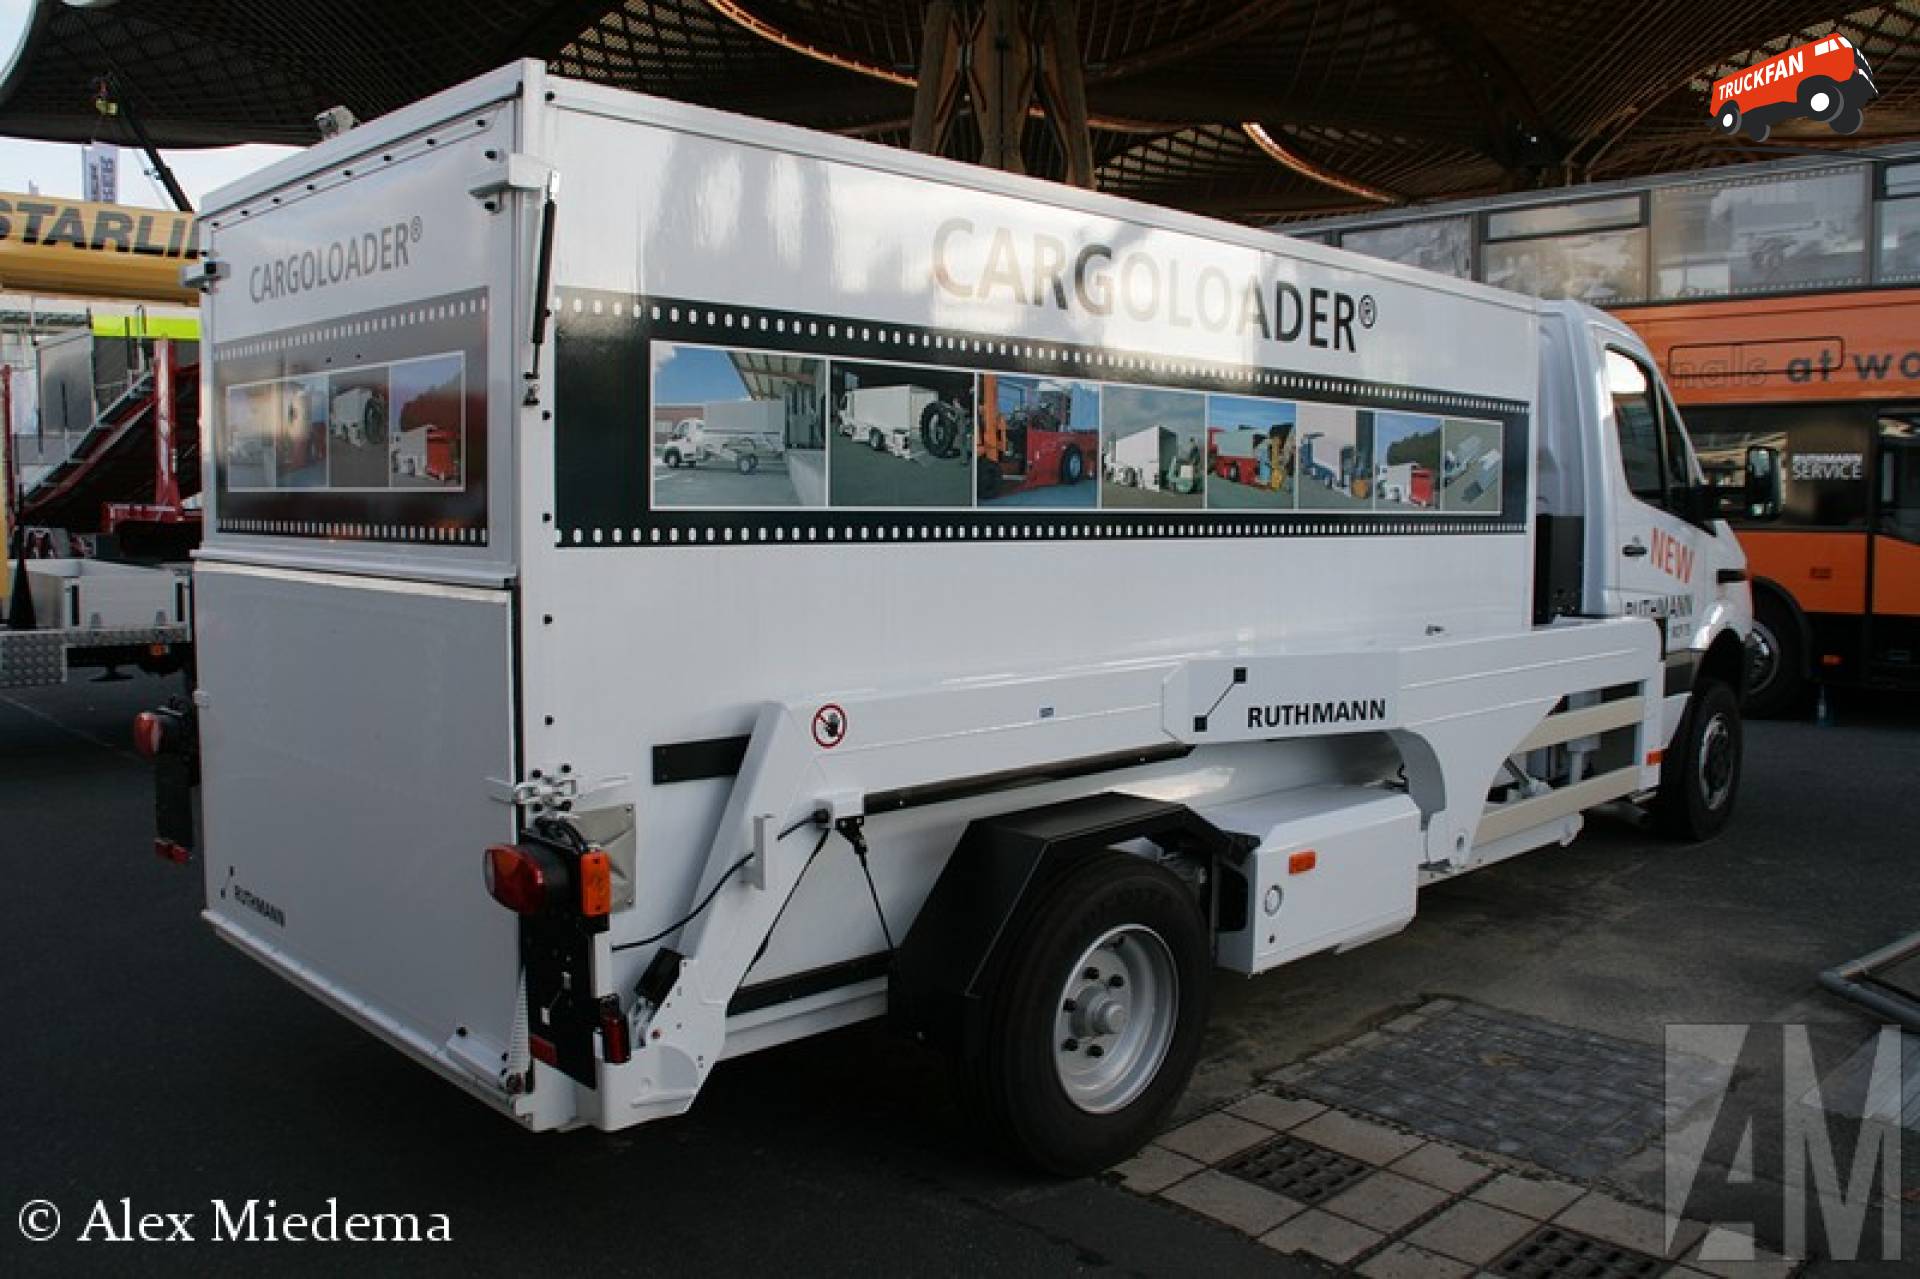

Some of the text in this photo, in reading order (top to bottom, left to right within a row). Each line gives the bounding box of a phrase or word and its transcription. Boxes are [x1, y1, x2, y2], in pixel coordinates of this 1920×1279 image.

[1787, 349, 1833, 383] at
[1792, 463, 1863, 480] SERVICE
[1650, 526, 1696, 585] NEW
[1247, 699, 1386, 729] RUTHMANN
